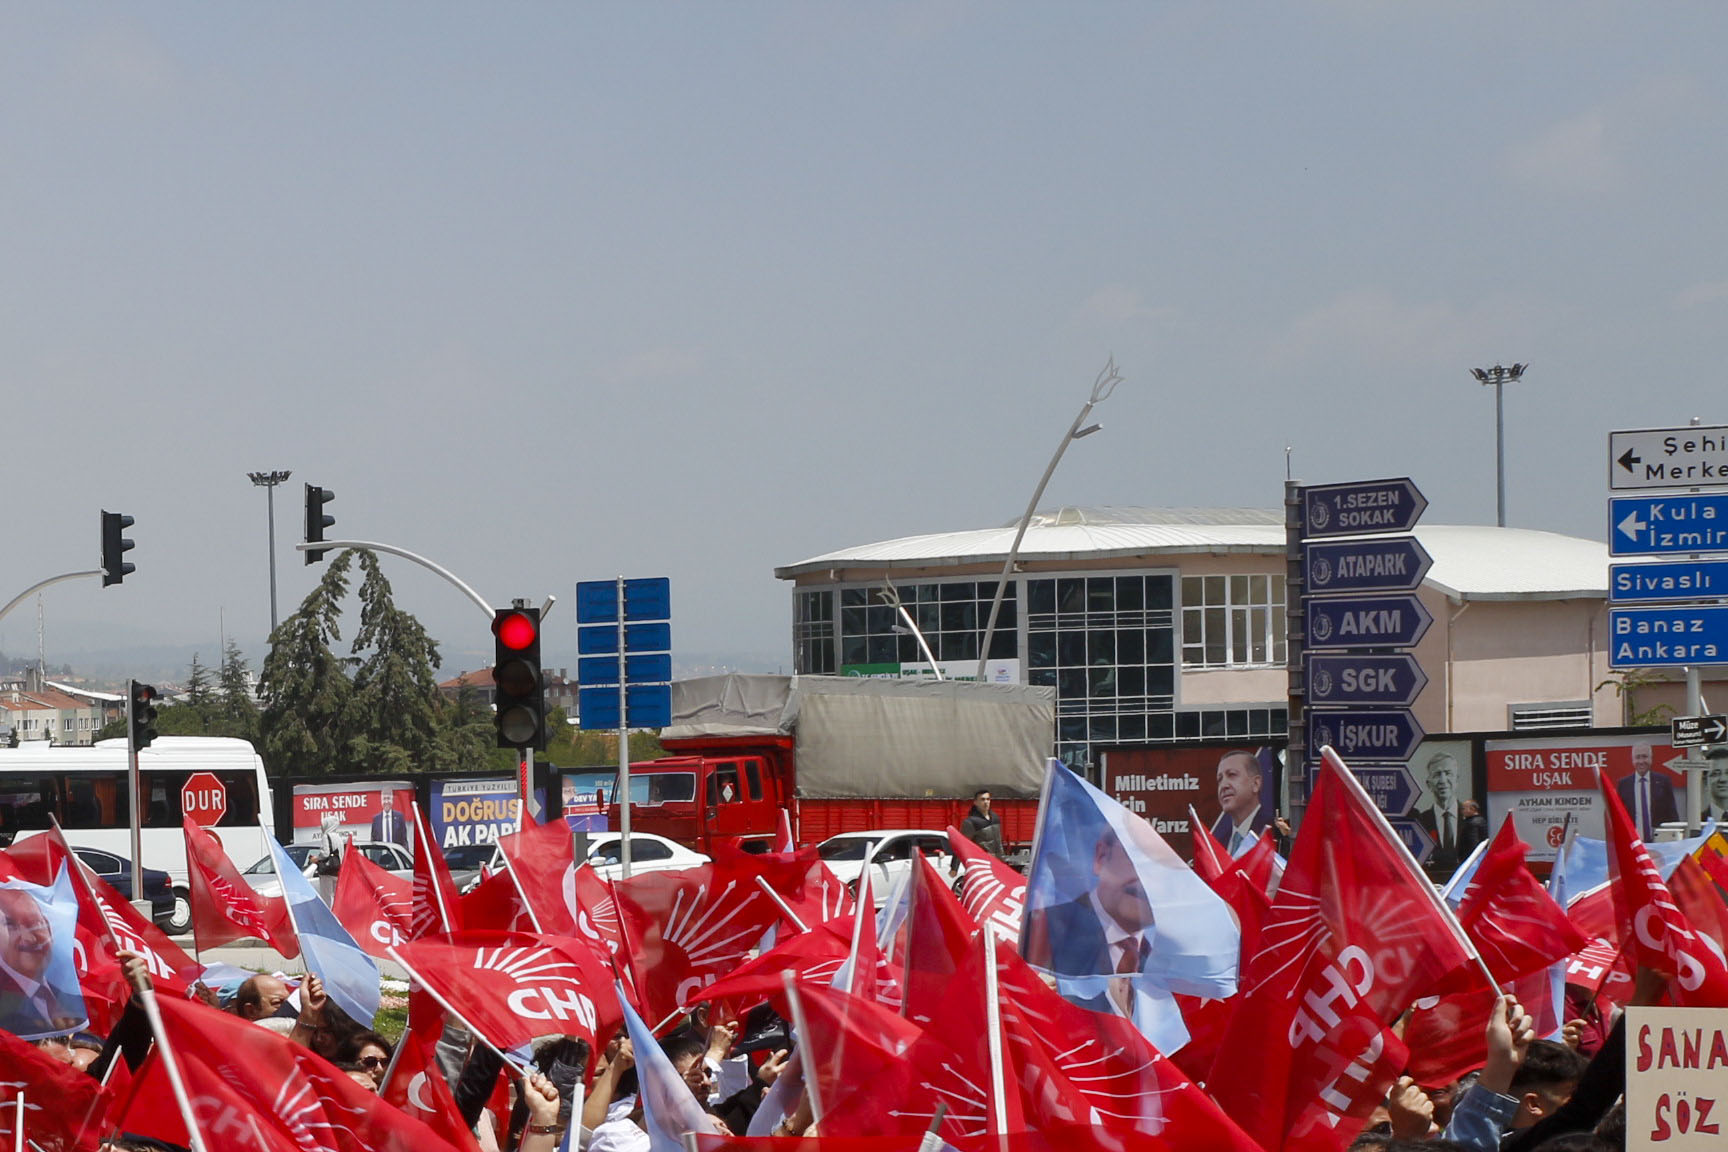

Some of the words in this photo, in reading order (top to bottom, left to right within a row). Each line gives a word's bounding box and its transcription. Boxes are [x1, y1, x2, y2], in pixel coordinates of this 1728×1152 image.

[1663, 435, 1725, 456] Şehi
[1334, 490, 1400, 509] 1.SEZEN
[1339, 509, 1395, 527] SOKAK
[1650, 502, 1716, 521] Kula
[1650, 525, 1726, 546] İzmir
[1337, 553, 1407, 578] ATAPARK
[1617, 571, 1711, 591] Sivaslı
[1339, 610, 1401, 635] AKM
[1616, 617, 1704, 635] Banaz
[1617, 641, 1717, 660] Ankara
[1341, 668, 1397, 692] SGK
[1339, 720, 1398, 752] İŞKUR
[1504, 754, 1545, 770] SIRA
[1550, 752, 1608, 769] SENDE
[1115, 773, 1200, 791] Milletimiz
[1532, 772, 1572, 789] UŞAK
[185, 789, 222, 811] DUR
[303, 797, 329, 810] SIRA
[332, 795, 368, 808] SENDE
[443, 825, 472, 848] AK
[1288, 945, 1375, 1049] CHP
[507, 986, 598, 1037] CHP
[1636, 1023, 1728, 1073] SANA
[1650, 1091, 1720, 1142] SÖZ
